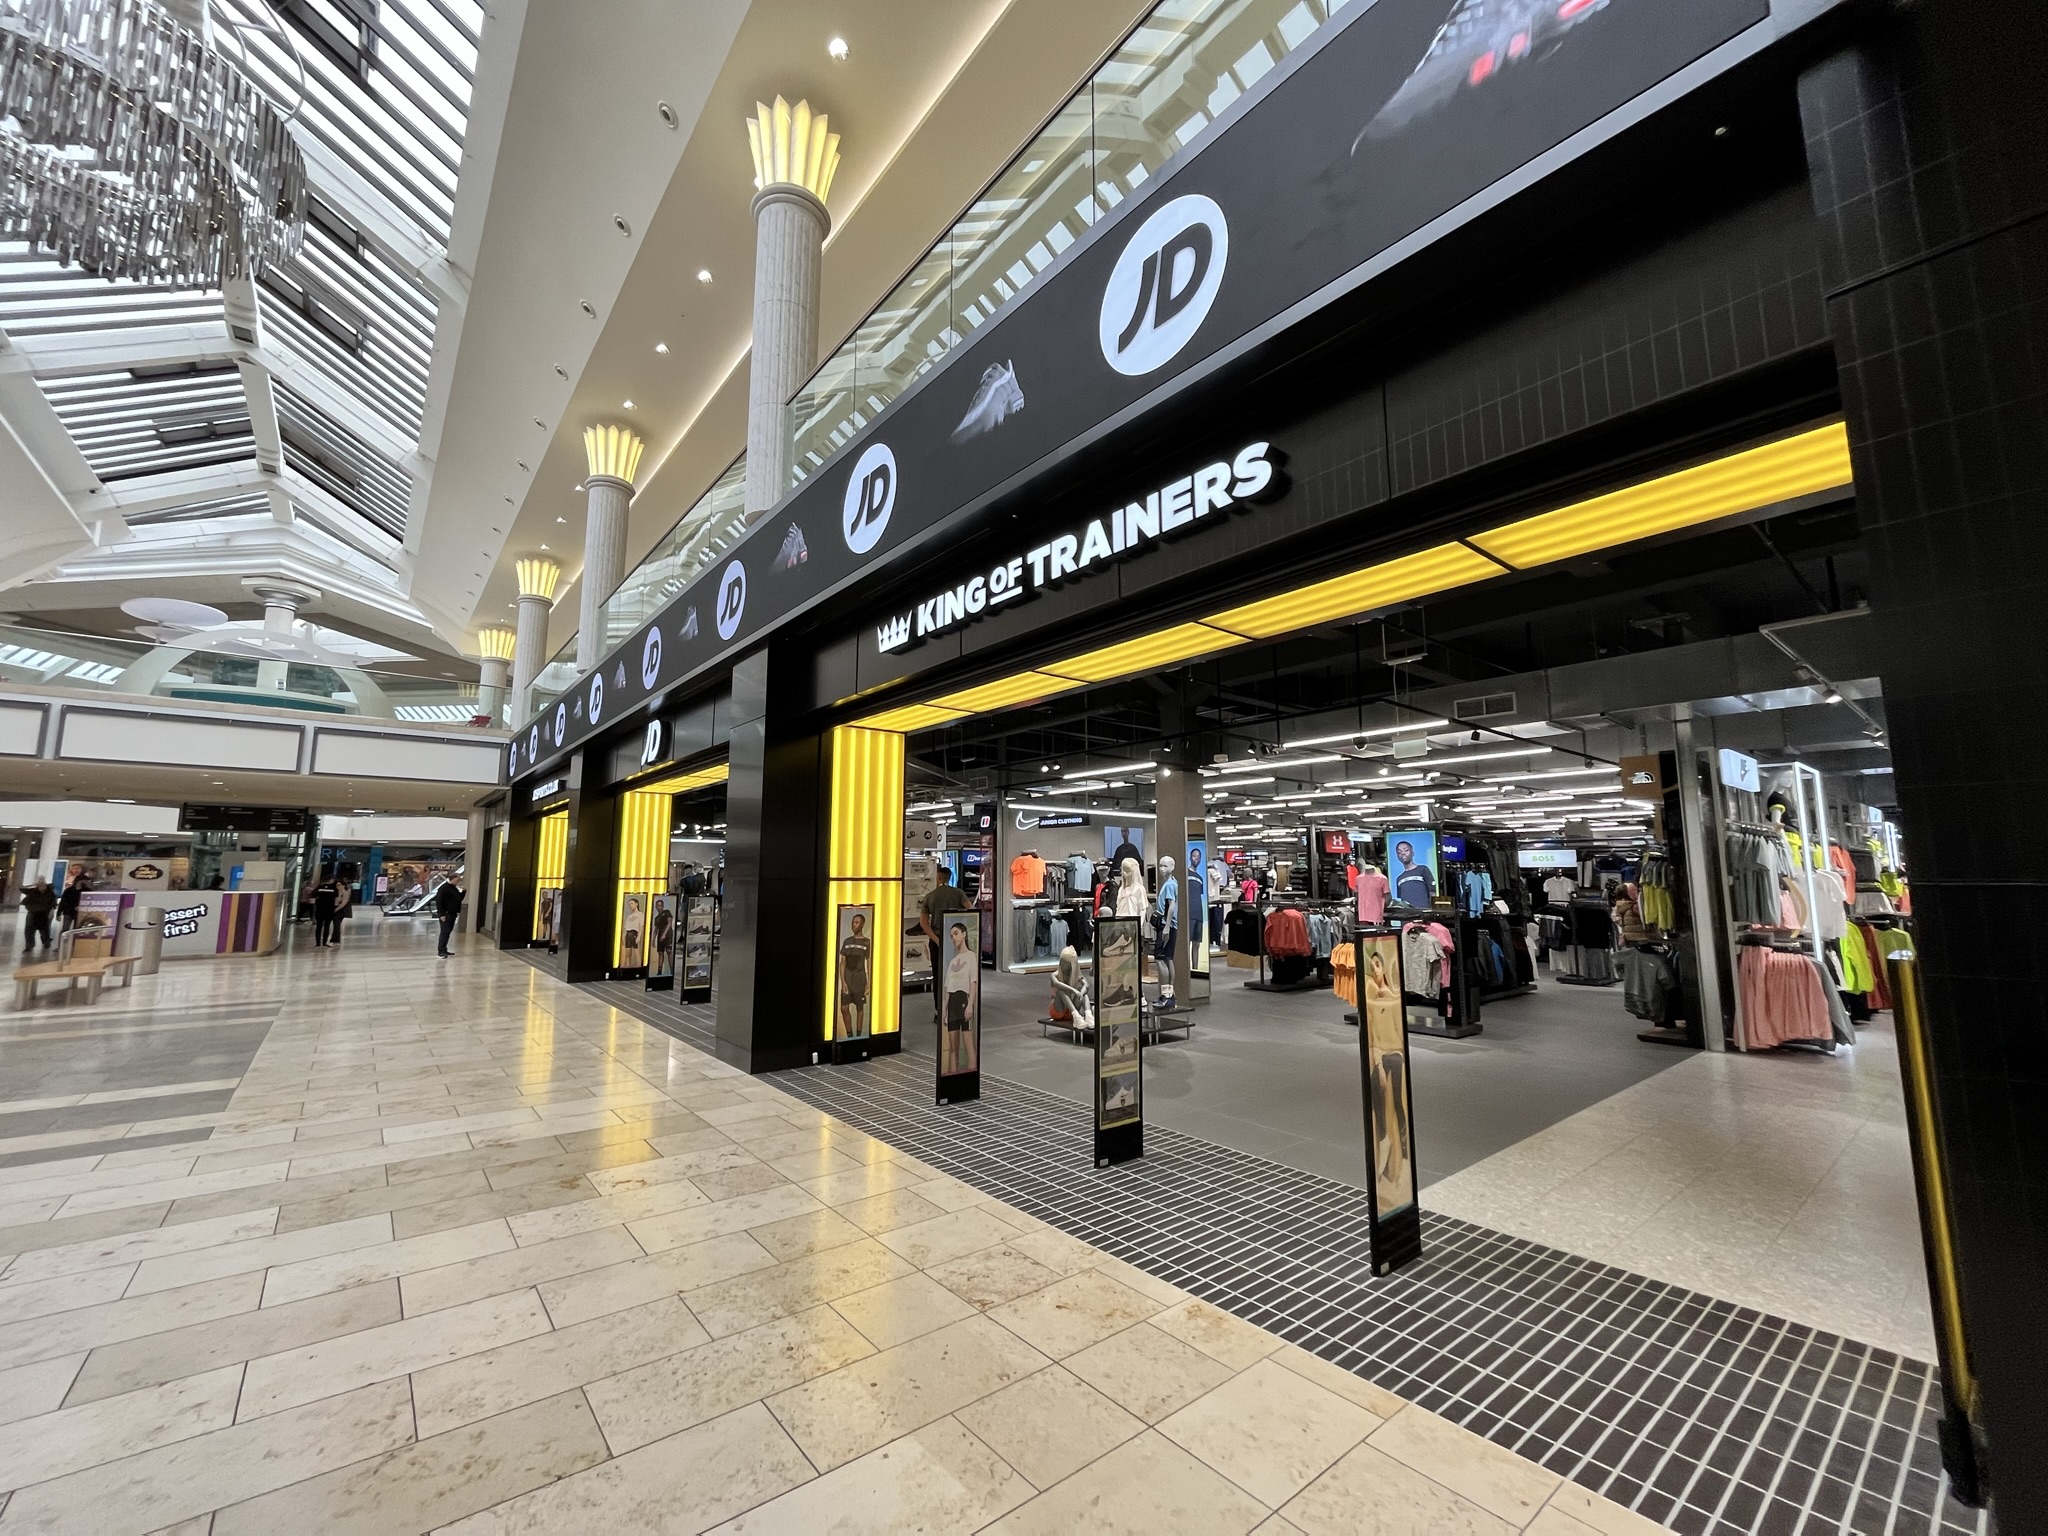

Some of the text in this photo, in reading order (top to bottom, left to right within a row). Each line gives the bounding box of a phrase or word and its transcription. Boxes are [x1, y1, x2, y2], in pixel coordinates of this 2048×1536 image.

[1117, 221, 1213, 355] JD
[850, 462, 891, 538] JD
[916, 440, 1274, 638] KING OF TRAINERS
[641, 719, 662, 767] JD
[163, 920, 197, 937] first
[164, 904, 206, 922] essert
